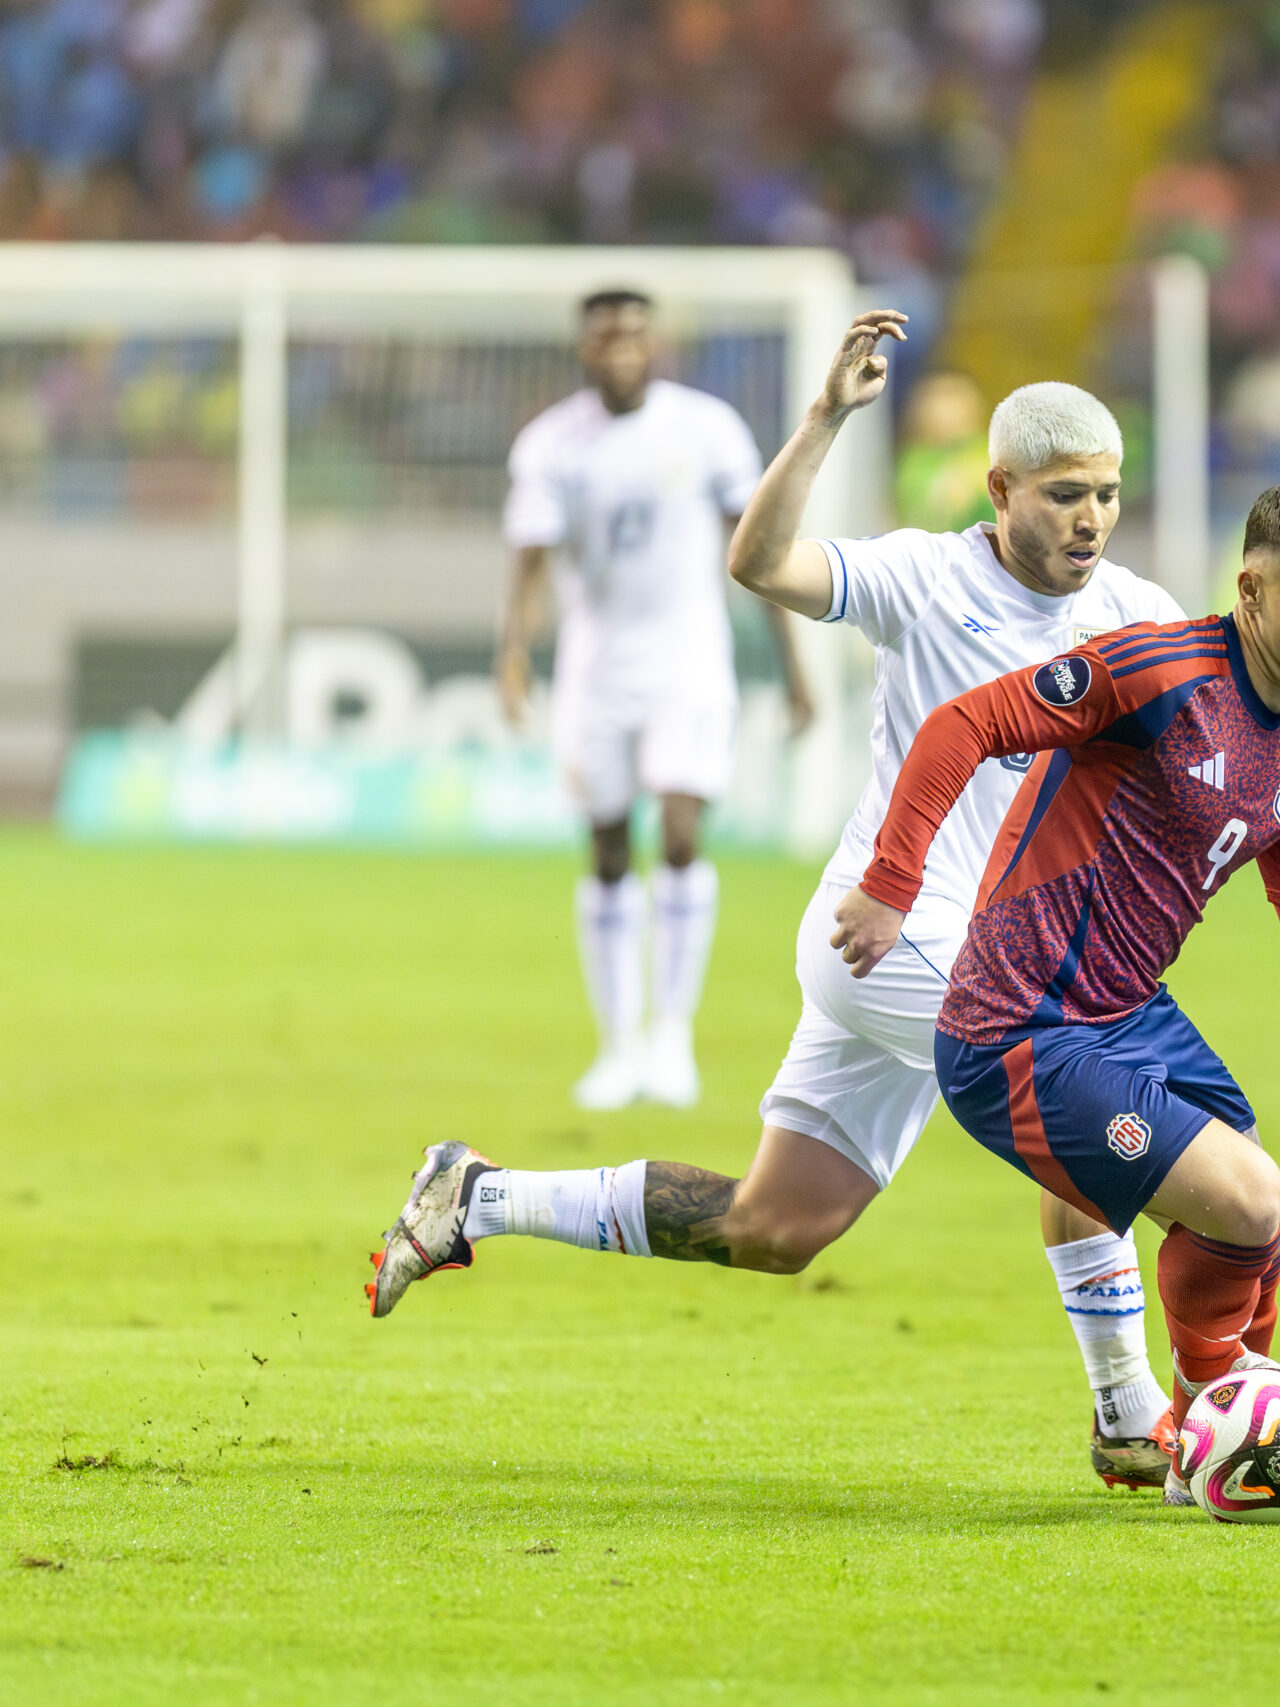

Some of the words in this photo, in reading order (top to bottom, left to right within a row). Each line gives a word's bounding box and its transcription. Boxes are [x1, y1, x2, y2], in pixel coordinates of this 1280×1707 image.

[1054, 674, 1073, 701] LEAGUE
[1201, 817, 1248, 891] 9
[1113, 1121, 1144, 1152] CR
